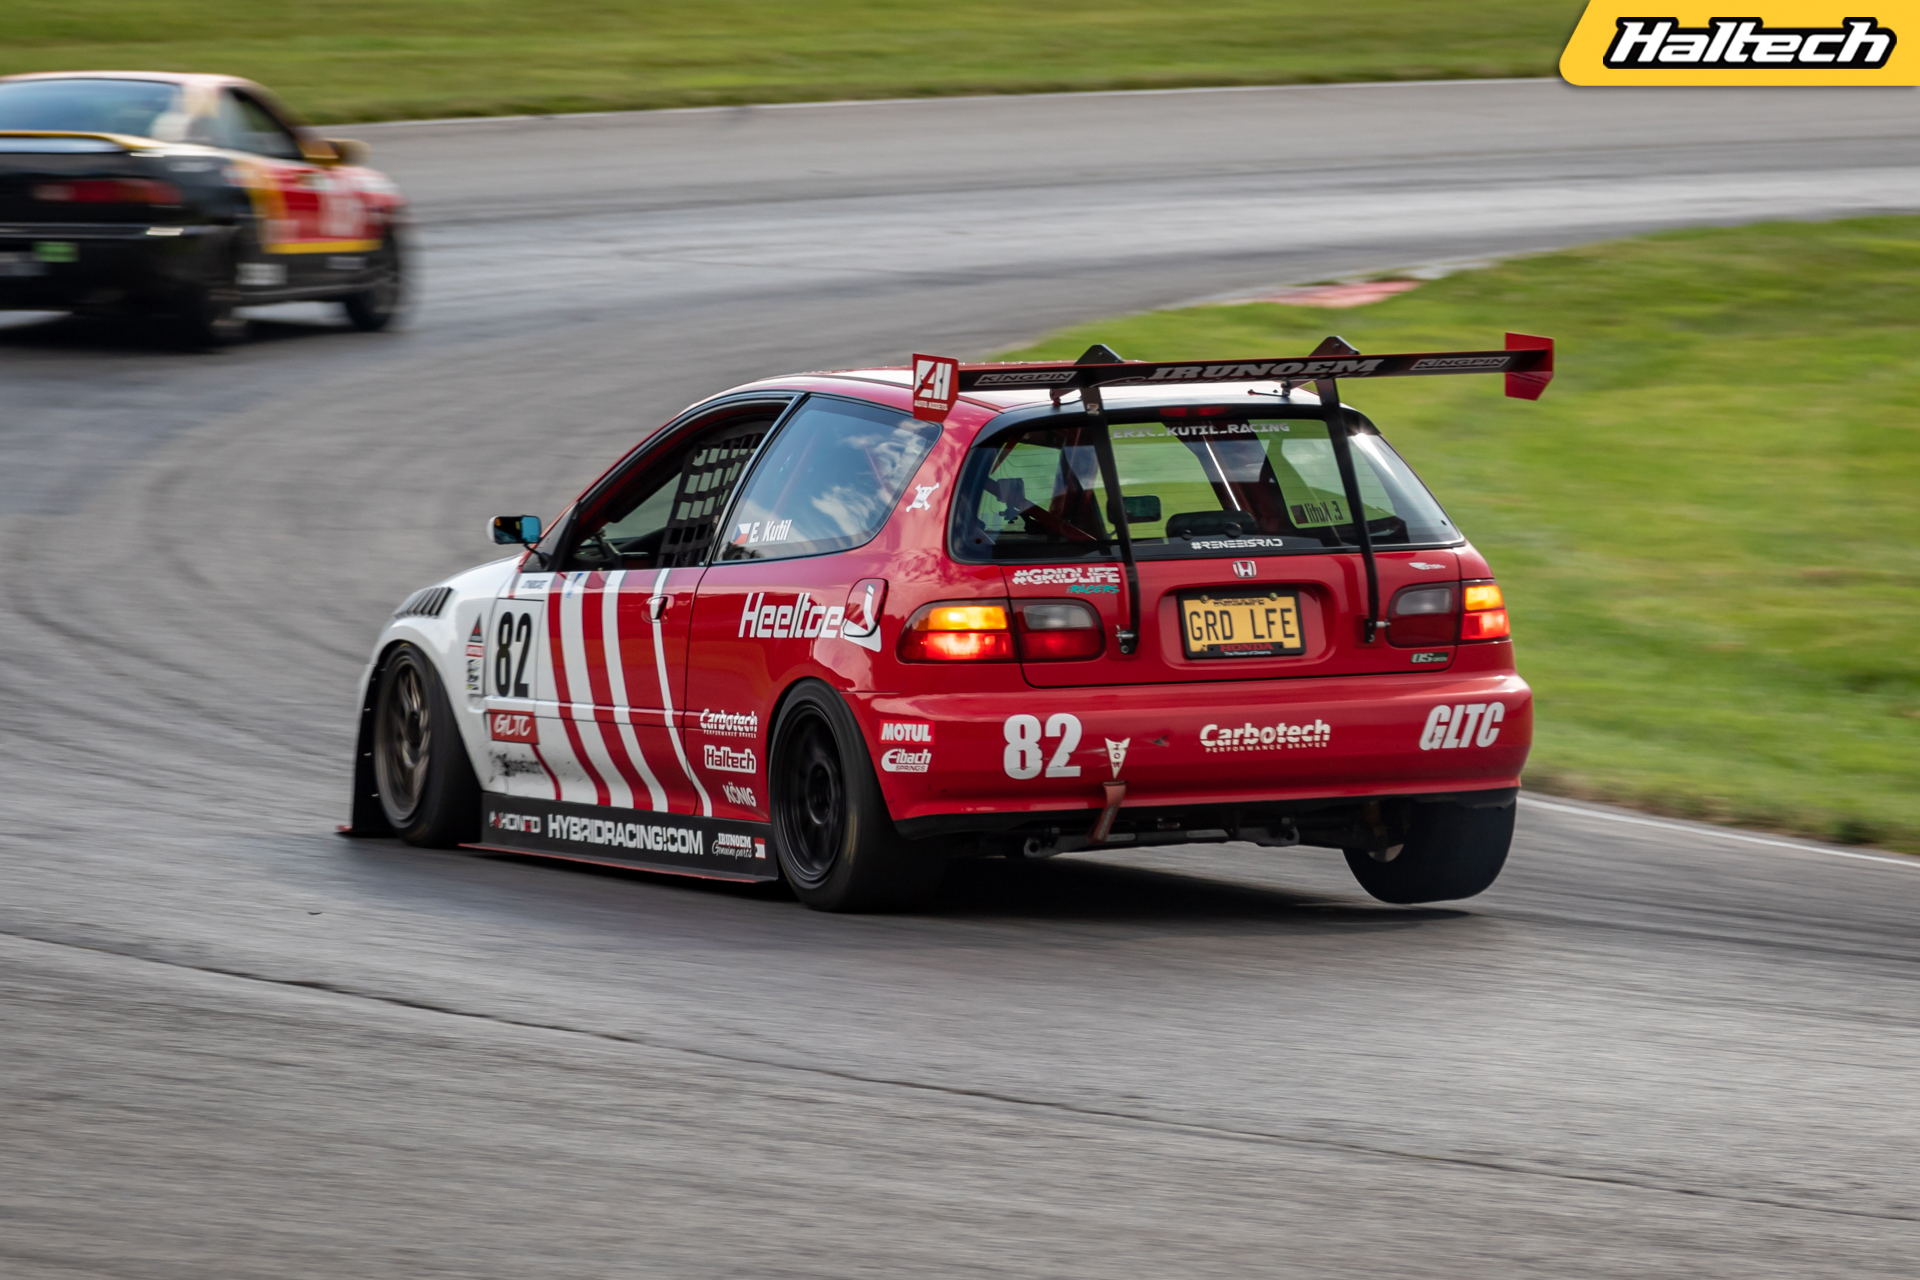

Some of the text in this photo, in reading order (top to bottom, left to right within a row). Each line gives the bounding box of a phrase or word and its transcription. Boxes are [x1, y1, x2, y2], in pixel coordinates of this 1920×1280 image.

[1148, 359, 1384, 380] IRUNOEM
[1418, 357, 1506, 368] KINGPIN
[979, 373, 1072, 383] KINGPIN
[749, 519, 793, 543] E. Kutil
[1191, 538, 1284, 550] #RENEEISRAD
[1012, 566, 1121, 585] #GRIDLIFE
[1189, 608, 1296, 641] GRD LFE
[495, 611, 532, 697] 82
[1219, 643, 1274, 652] HONDA
[493, 713, 532, 737] GLTC
[699, 708, 758, 733] Carbotech
[881, 722, 932, 742] MOTUL
[1419, 702, 1505, 750] GLTC
[1200, 719, 1331, 747] Carbotech
[1003, 713, 1083, 780] 82
[1205, 744, 1282, 753] PERFORMANCE
[705, 747, 756, 771] Haltech
[881, 748, 932, 771] Eibach
[723, 781, 757, 807] KÖNIG
[718, 832, 752, 848] IRUNOEM
